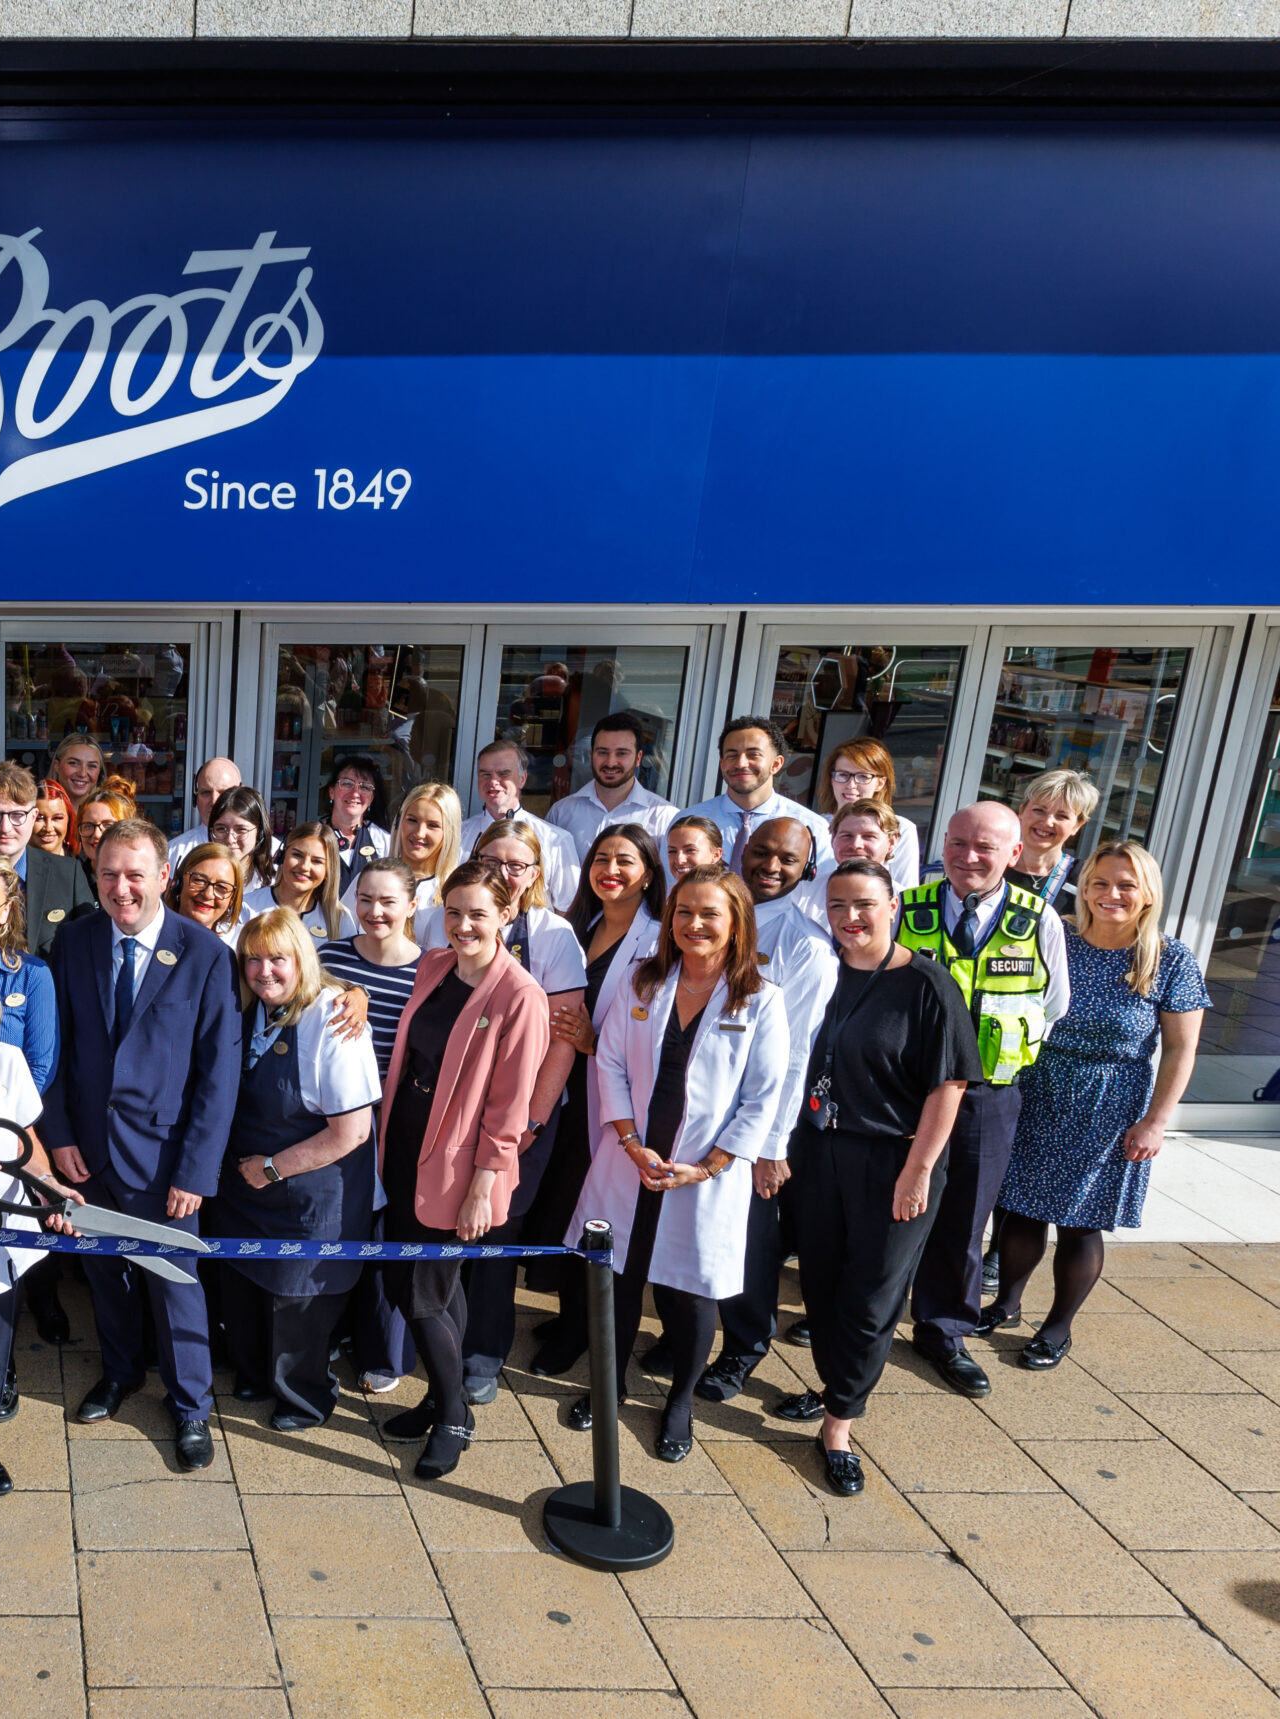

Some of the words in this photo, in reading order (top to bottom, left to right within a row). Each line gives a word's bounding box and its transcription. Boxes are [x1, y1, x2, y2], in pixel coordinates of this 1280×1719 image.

[183, 468, 296, 510] Since
[314, 468, 412, 510] 1849
[990, 960, 1033, 972] SECURITY
